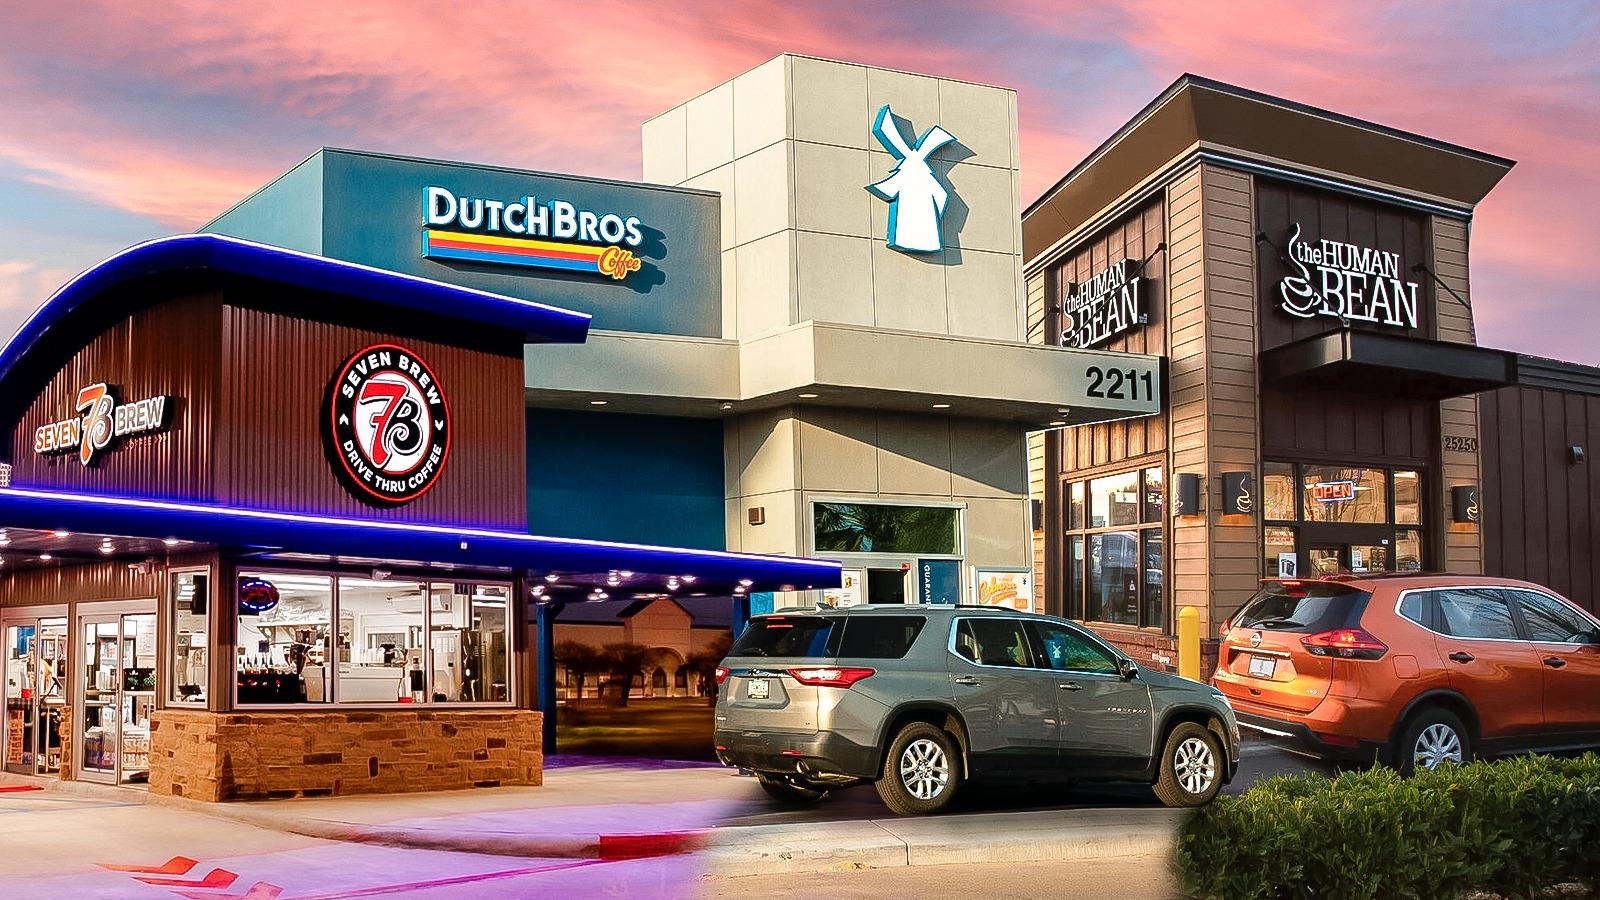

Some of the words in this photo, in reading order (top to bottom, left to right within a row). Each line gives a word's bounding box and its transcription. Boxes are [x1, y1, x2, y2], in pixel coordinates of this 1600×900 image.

[599, 247, 640, 278] Coffee
[1078, 276, 1140, 349] BEAN
[1317, 265, 1419, 329] BEAN
[342, 351, 392, 399] SEVEN
[398, 354, 441, 405] BREW
[1085, 366, 1153, 401] 2211
[35, 417, 81, 453] SEVEN
[115, 395, 165, 436] BREW
[1444, 436, 1478, 452] 25250
[343, 439, 374, 482] DRIVE
[374, 475, 406, 492] THRU
[408, 443, 442, 489] COFFEE
[1313, 484, 1352, 499] OPEN
